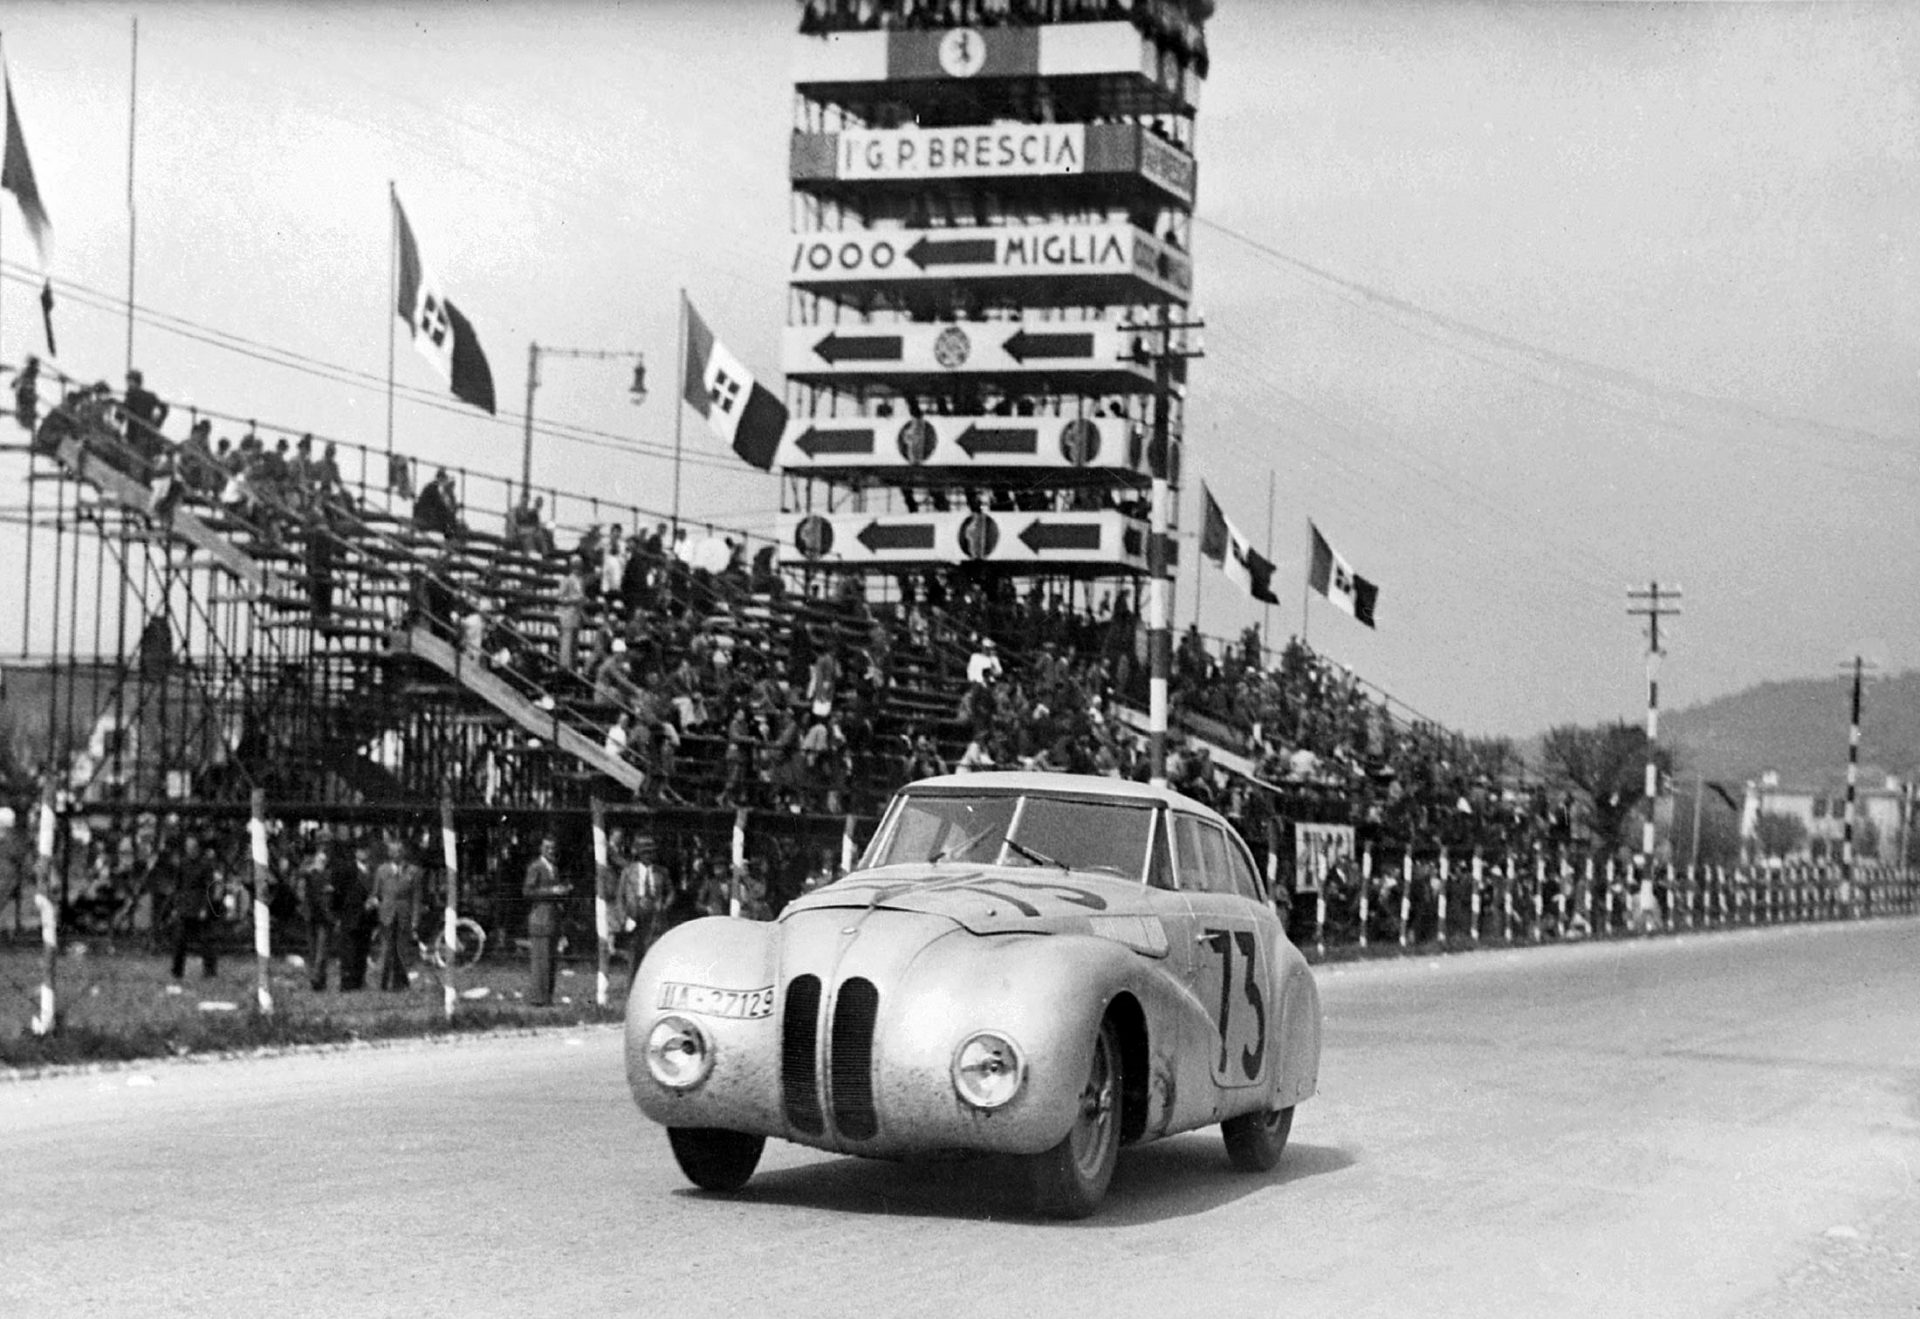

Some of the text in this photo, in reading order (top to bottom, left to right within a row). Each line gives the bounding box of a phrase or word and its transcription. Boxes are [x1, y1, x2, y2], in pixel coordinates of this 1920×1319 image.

[929, 134, 1076, 168] BRESCIA
[791, 241, 895, 273] 1000
[1003, 234, 1125, 266] MIGLIA
[1204, 928, 1265, 1081] 73
